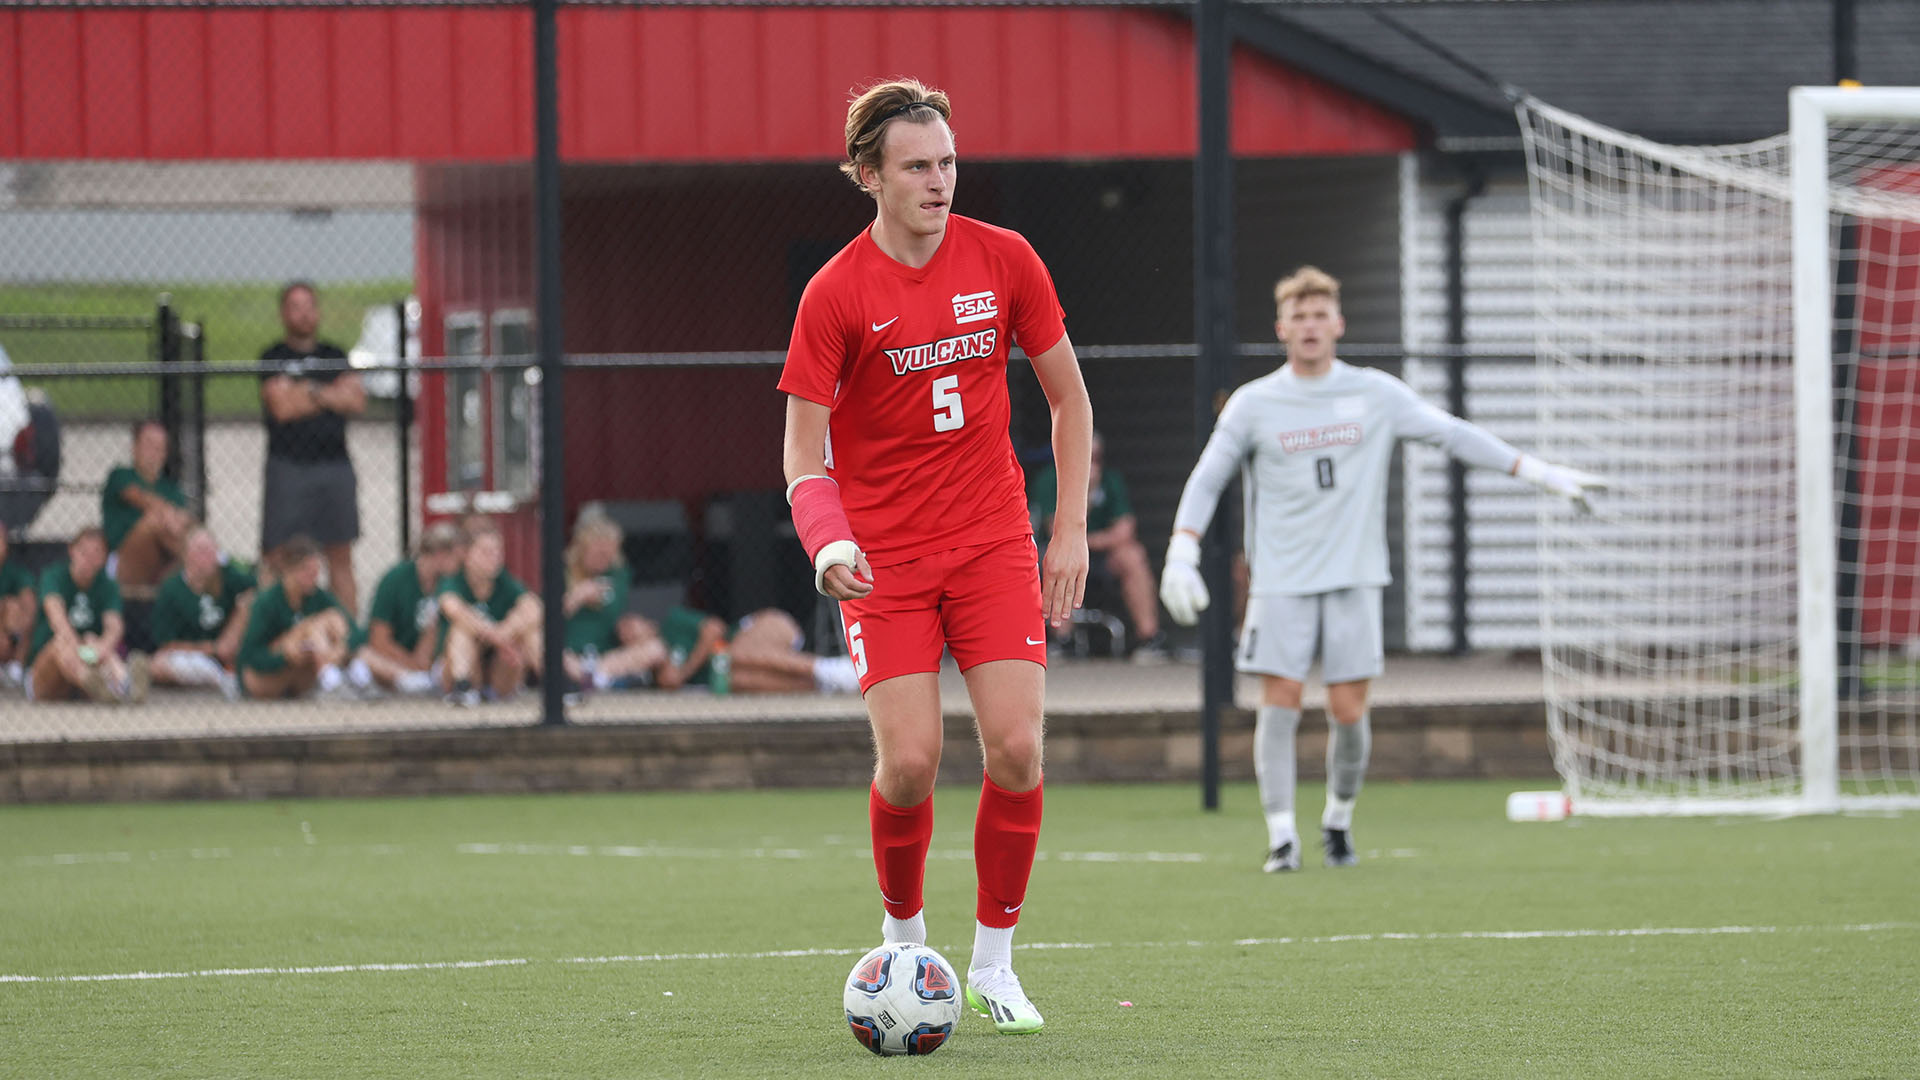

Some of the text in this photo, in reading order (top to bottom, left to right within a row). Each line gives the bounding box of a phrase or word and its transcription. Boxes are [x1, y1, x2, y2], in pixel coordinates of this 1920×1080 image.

[953, 297, 998, 317] PSAC
[883, 328, 997, 376] VULCANS
[932, 374, 965, 432] 5
[848, 621, 869, 680] 5
